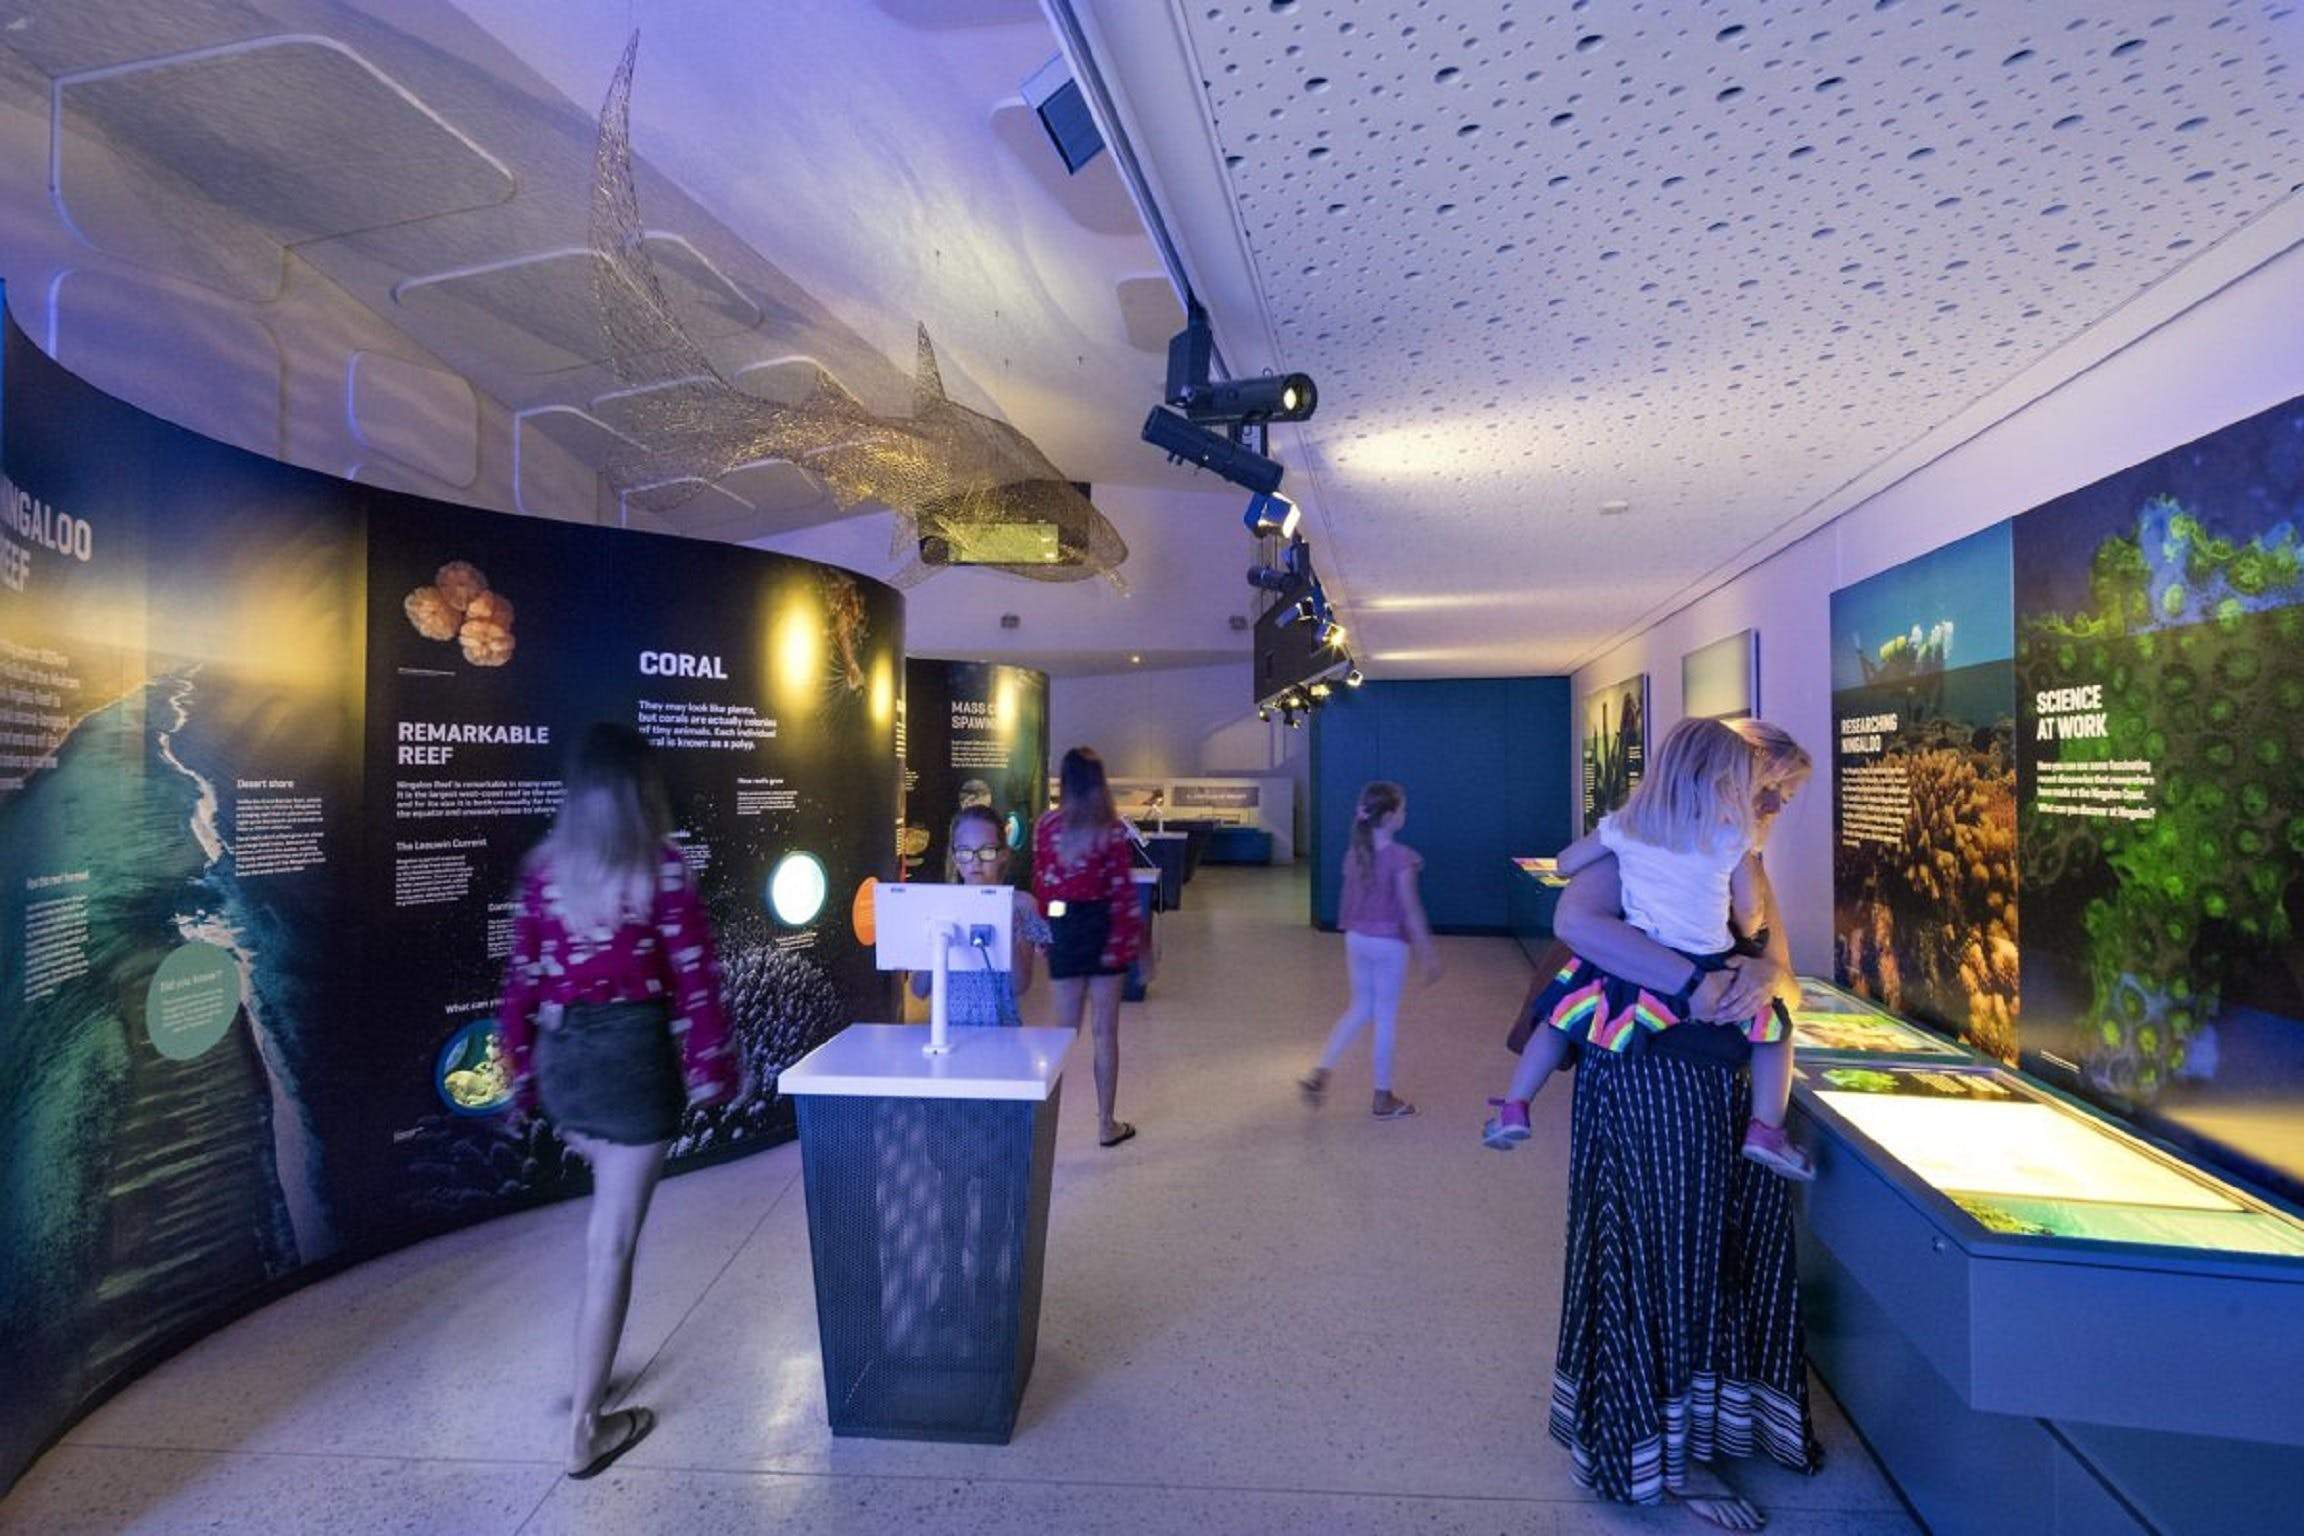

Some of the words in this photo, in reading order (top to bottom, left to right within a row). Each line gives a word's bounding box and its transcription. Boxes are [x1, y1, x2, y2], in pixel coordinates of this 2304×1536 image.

[639, 650, 728, 679] CORAL
[2036, 685, 2103, 713] SCIENCE
[638, 700, 663, 712] They
[665, 703, 687, 714] may
[689, 702, 707, 712] look
[710, 703, 725, 713] like
[728, 704, 756, 716] plants,
[951, 701, 986, 715] MASS
[638, 713, 658, 723] but
[659, 713, 689, 723] corals
[691, 716, 706, 724] are
[708, 715, 742, 727] actually
[745, 717, 777, 727] colonies
[1840, 713, 1898, 734] RESEARCHING
[2037, 717, 2054, 740] AT
[2057, 713, 2108, 739] WORK
[398, 722, 550, 744] REMARKABLE
[638, 725, 650, 735] of
[652, 725, 671, 737] tiny
[673, 726, 711, 736] animals.
[714, 725, 735, 735] Each
[737, 728, 776, 738] individual
[667, 738, 676, 747] is
[678, 738, 709, 748] known
[711, 740, 723, 748] as
[730, 739, 755, 750] polyp.
[398, 746, 453, 765] REEF
[237, 779, 267, 788] Desert
[269, 779, 294, 788] shore
[397, 781, 432, 790] Ningaloo
[434, 781, 452, 789] Reef
[454, 781, 461, 789] is
[463, 781, 507, 789] remarkable
[509, 781, 516, 789] in
[397, 790, 403, 799] It
[405, 790, 412, 799] is
[414, 790, 427, 799] the
[428, 790, 457, 801] largest
[459, 790, 504, 799] west-coast
[505, 790, 521, 799] reef
[522, 790, 530, 799] in
[532, 790, 545, 799] the
[2091, 788, 2122, 801] Ningaloo
[397, 798, 413, 807] and
[414, 798, 425, 807] for
[428, 798, 439, 807] its
[440, 798, 455, 807] size
[457, 798, 463, 807] it
[465, 798, 471, 807] is
[474, 798, 492, 807] both
[493, 798, 530, 809] unusually
[533, 798, 543, 807] far
[397, 808, 411, 817] the
[413, 809, 443, 818] equator
[445, 808, 462, 817] and
[463, 807, 499, 818] unusually
[523, 806, 532, 815] to
[396, 842, 413, 851] The
[415, 840, 451, 850] Leeuwin
[452, 838, 487, 848] Current
[445, 1003, 469, 1014] What
[471, 1001, 488, 1010] can
